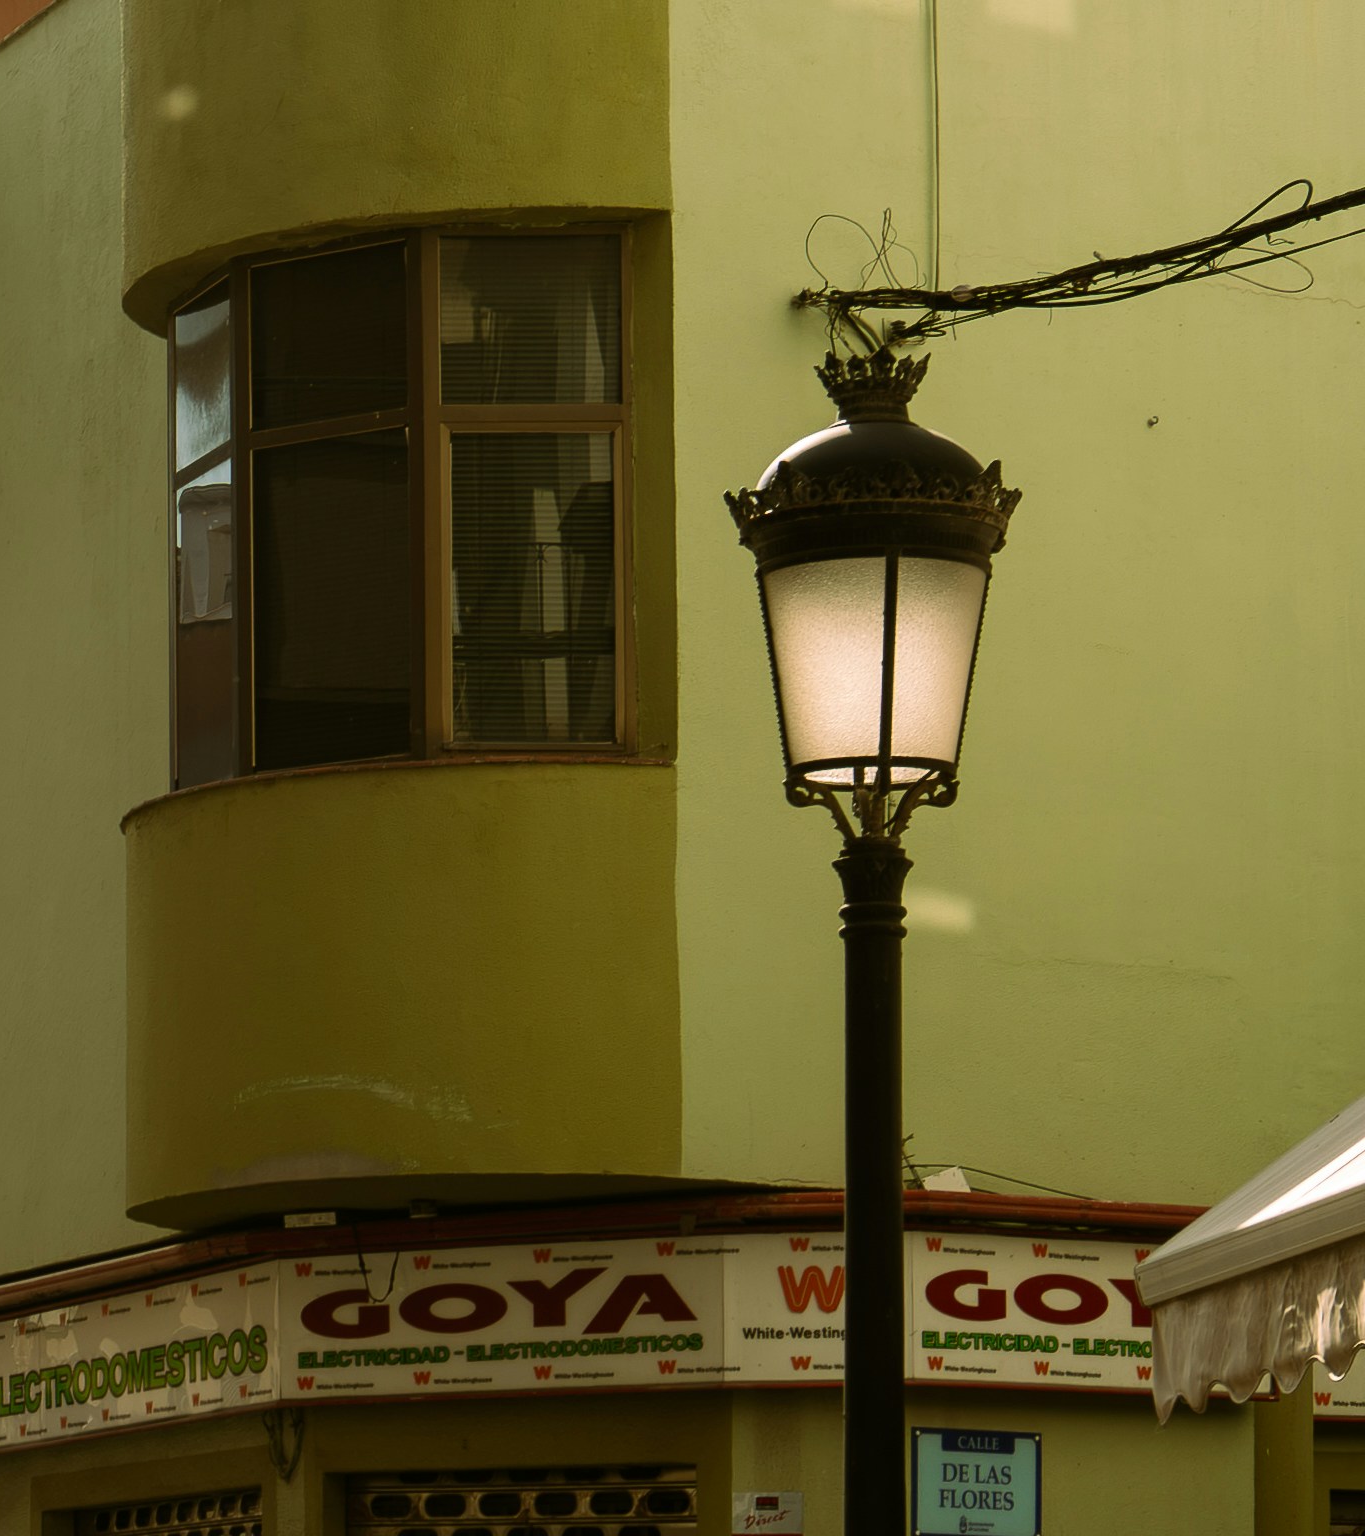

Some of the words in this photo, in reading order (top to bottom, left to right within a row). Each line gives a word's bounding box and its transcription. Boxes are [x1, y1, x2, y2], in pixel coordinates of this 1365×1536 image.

[301, 1267, 698, 1339] GOYA
[777, 1265, 845, 1314] W
[925, 1269, 1152, 1328] GOY
[742, 1326, 845, 1341] White-Westing
[922, 1330, 1058, 1354] ELECTRICIDAD
[1073, 1338, 1152, 1358] ELECTRO
[297, 1346, 451, 1369] ELECTRICIDAD
[466, 1333, 703, 1362] ELECTRODOMESTICOS
[957, 1435, 1000, 1450] CALLE
[941, 1462, 969, 1483] DE
[974, 1464, 1012, 1486] LAS
[939, 1488, 1015, 1511] FLORES
